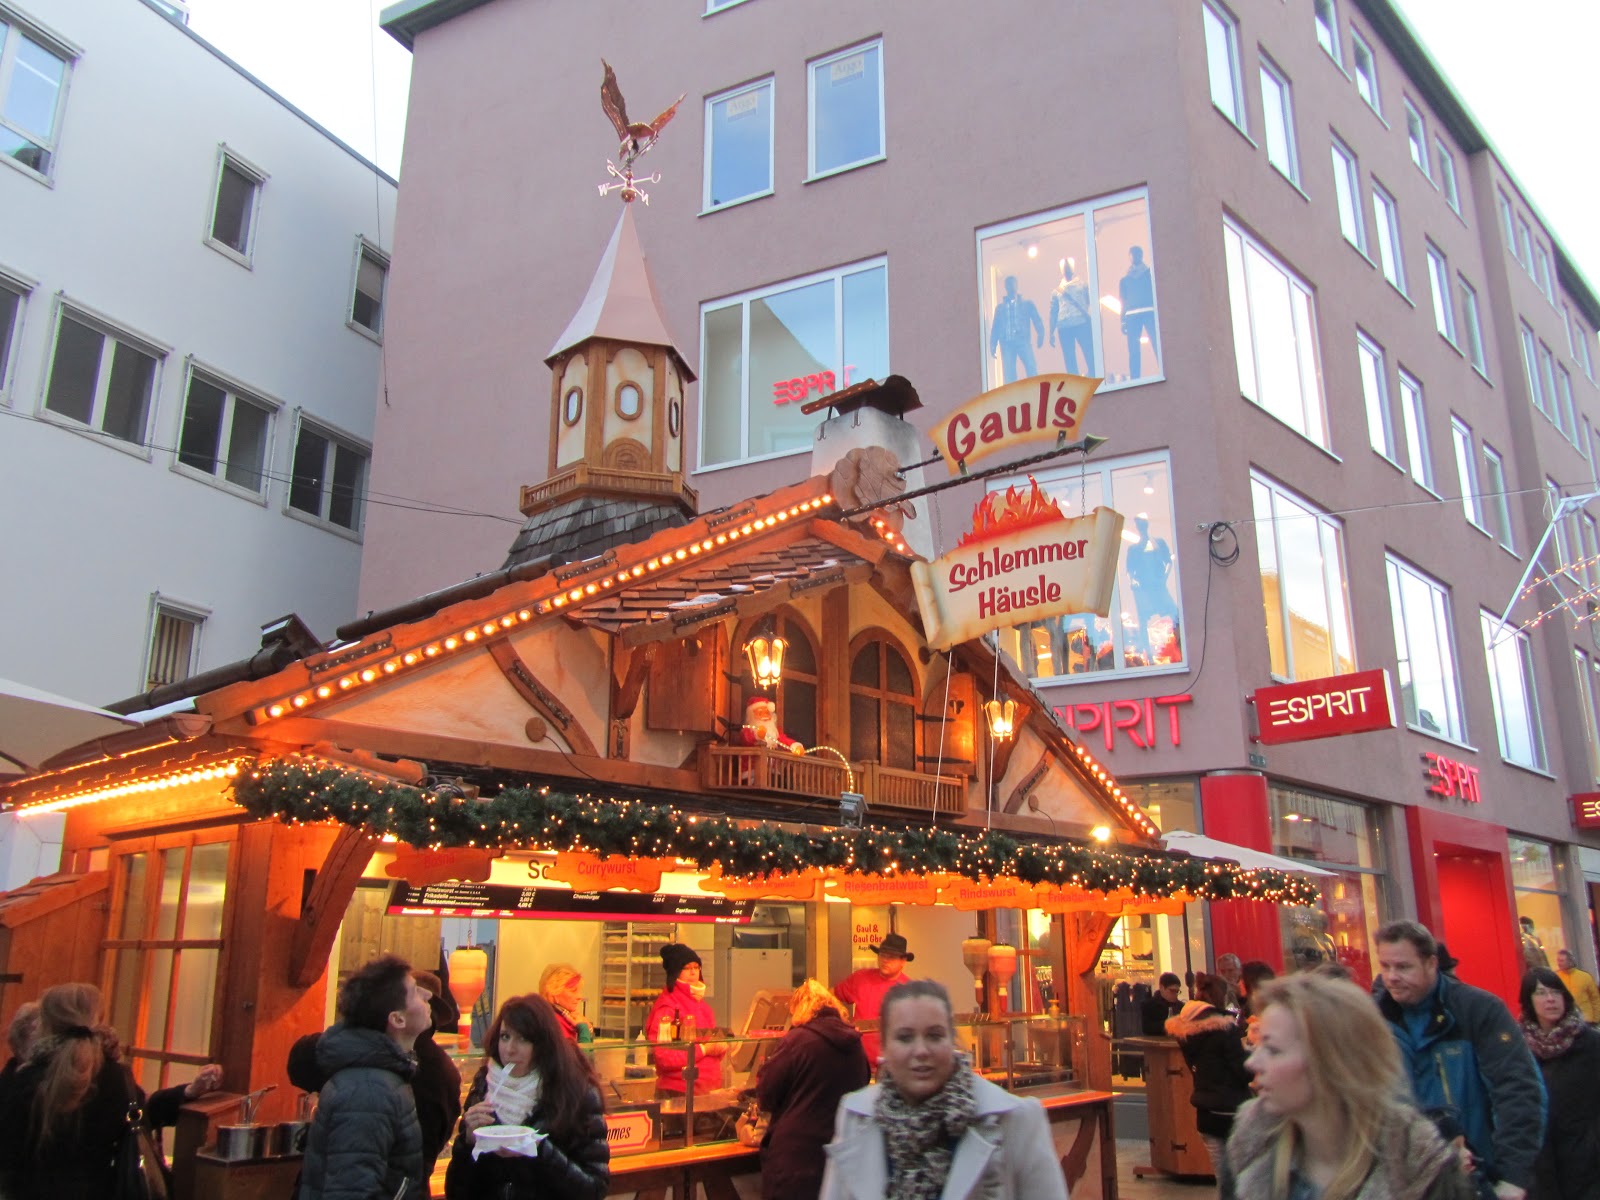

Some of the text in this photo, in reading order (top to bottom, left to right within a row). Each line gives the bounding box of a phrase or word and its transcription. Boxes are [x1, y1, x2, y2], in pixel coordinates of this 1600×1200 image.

[949, 539, 1089, 593] Schlemmer
[978, 574, 1062, 620] Häusle
[1269, 686, 1371, 726] ESPRIT
[1424, 751, 1481, 803] ESPRIT
[577, 860, 637, 876] Currywurst
[844, 879, 929, 893] Riesenbratwurst
[959, 886, 1017, 899] Rindswurst
[856, 924, 879, 933] Gaul &
[853, 934, 868, 943] Gaul
